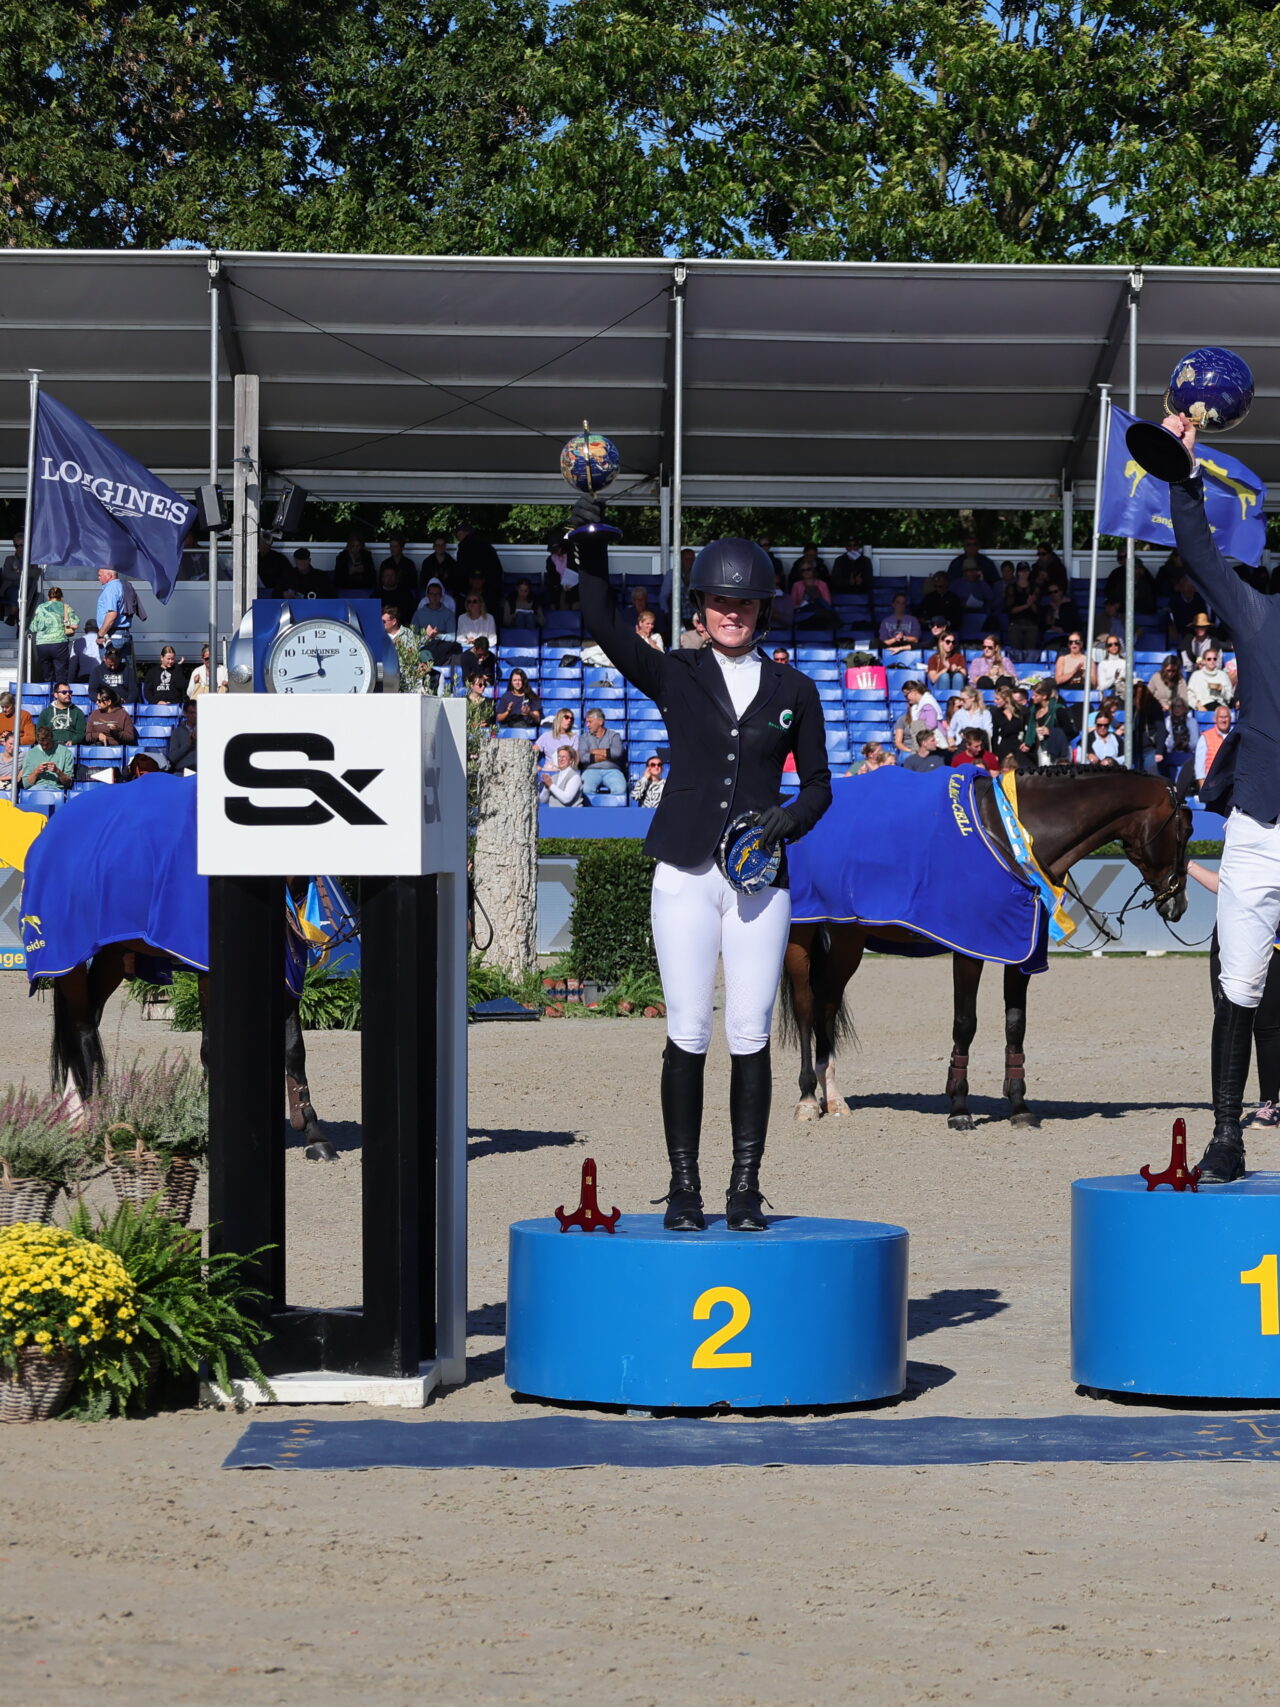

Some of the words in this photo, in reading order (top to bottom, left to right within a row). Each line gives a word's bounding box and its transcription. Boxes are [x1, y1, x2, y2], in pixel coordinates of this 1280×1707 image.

[41, 456, 189, 525] LONGINES
[314, 630, 327, 639] 12
[284, 649, 296, 657] 10
[349, 648, 358, 656] 2
[278, 668, 287, 677] 9
[354, 666, 364, 675] 3
[1240, 1254, 1280, 1336] 1
[691, 1286, 752, 1369] 2
